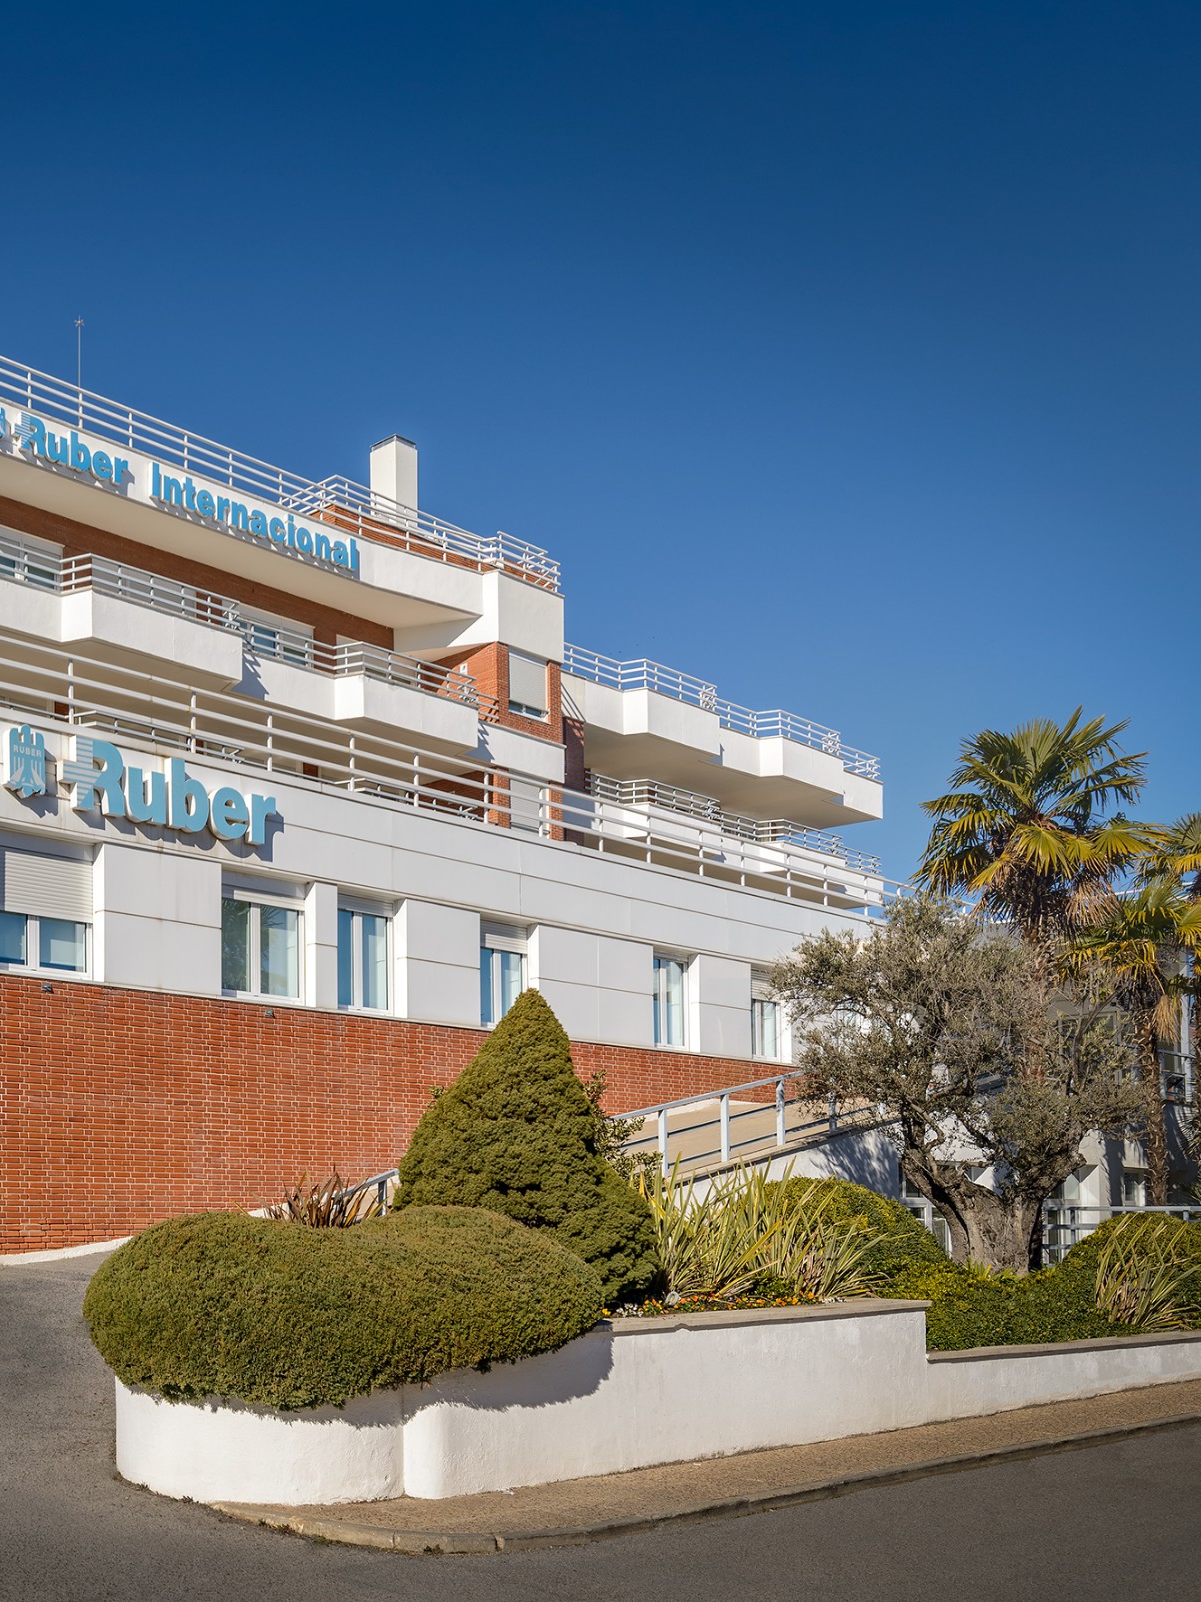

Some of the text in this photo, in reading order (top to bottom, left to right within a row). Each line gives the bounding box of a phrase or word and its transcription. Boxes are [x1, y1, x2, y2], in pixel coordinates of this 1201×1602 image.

[15, 411, 357, 571] Ruber Internacional
[13, 744, 43, 757] RUBER
[62, 735, 276, 845] Ruber
